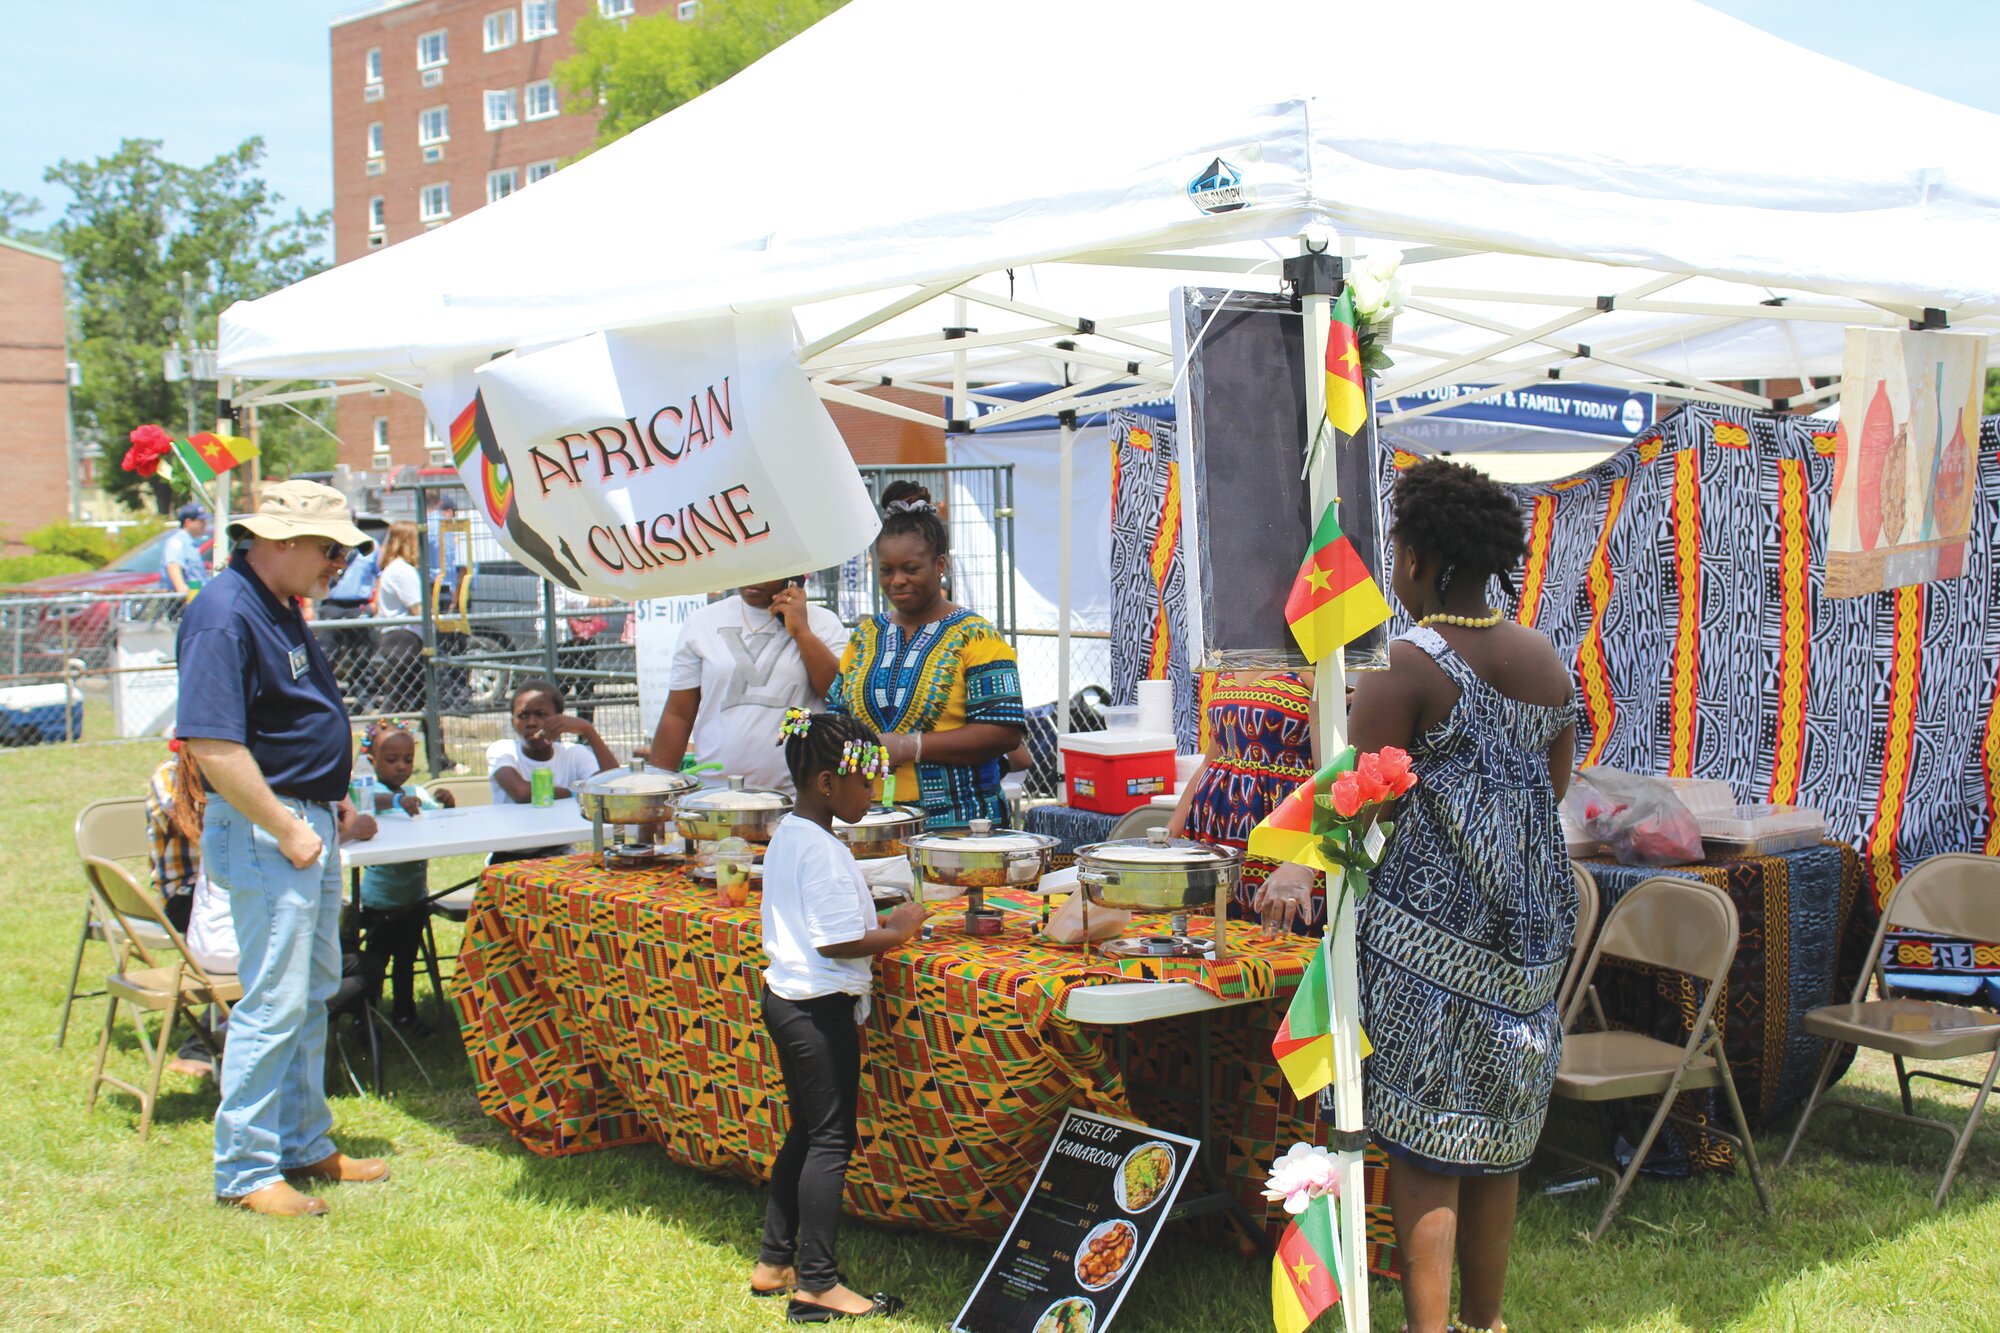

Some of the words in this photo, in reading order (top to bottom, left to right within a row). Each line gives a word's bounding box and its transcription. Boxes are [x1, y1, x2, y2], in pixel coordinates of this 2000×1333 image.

[1210, 187, 1243, 205] CANOPY
[1427, 385, 1459, 400] OUR
[1505, 390, 1517, 408] &
[1519, 392, 1570, 415] FAMILY
[1573, 399, 1617, 421] TODAY
[527, 376, 733, 495] AFRICAN
[587, 484, 770, 572] CUISINE
[1066, 1117, 1105, 1139] TASTE
[1101, 1127, 1122, 1143] OF
[1055, 1139, 1123, 1169] CAMAROON
[1086, 1202, 1099, 1213] $12
[1078, 1218, 1091, 1229] $15
